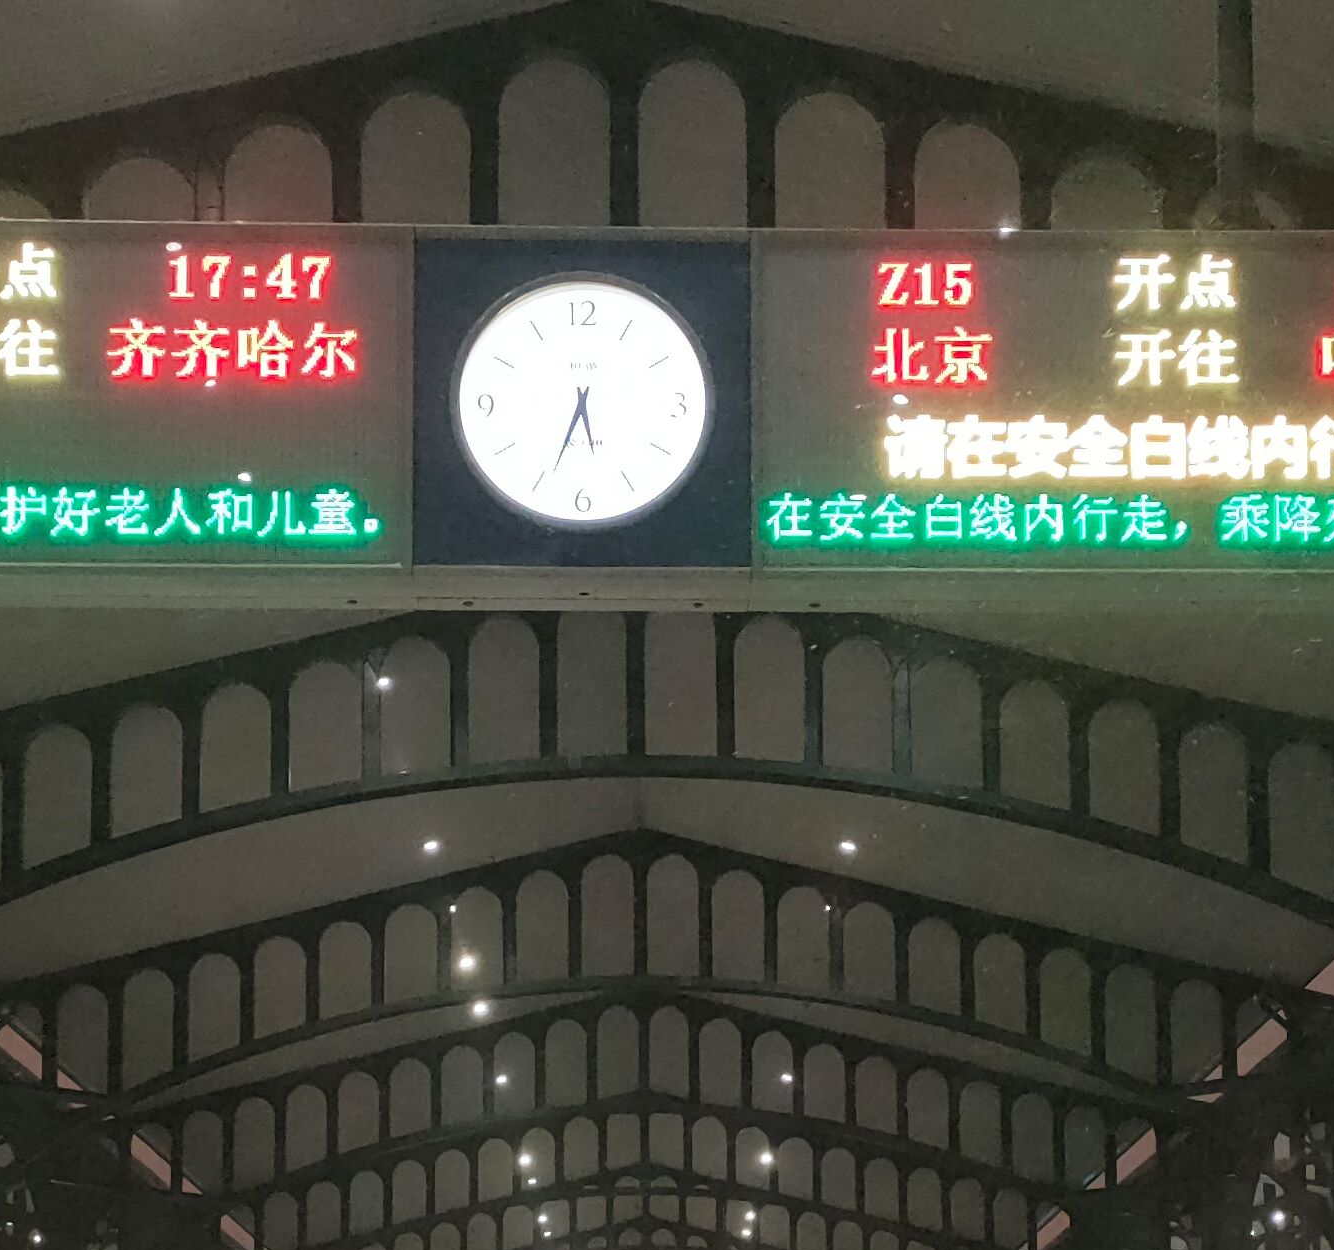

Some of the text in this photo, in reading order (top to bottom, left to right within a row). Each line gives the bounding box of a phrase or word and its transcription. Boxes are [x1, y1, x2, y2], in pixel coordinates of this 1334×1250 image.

[165, 254, 332, 300] 17:47
[877, 262, 972, 306] Z15
[1113, 254, 1236, 310] 开点
[568, 300, 597, 326] 12
[107, 318, 358, 378] 齐齐哈尔
[871, 326, 993, 384] 北京
[1115, 328, 1240, 386] 开往
[477, 394, 495, 417] 9
[671, 392, 687, 418] 3
[574, 488, 592, 513] 6
